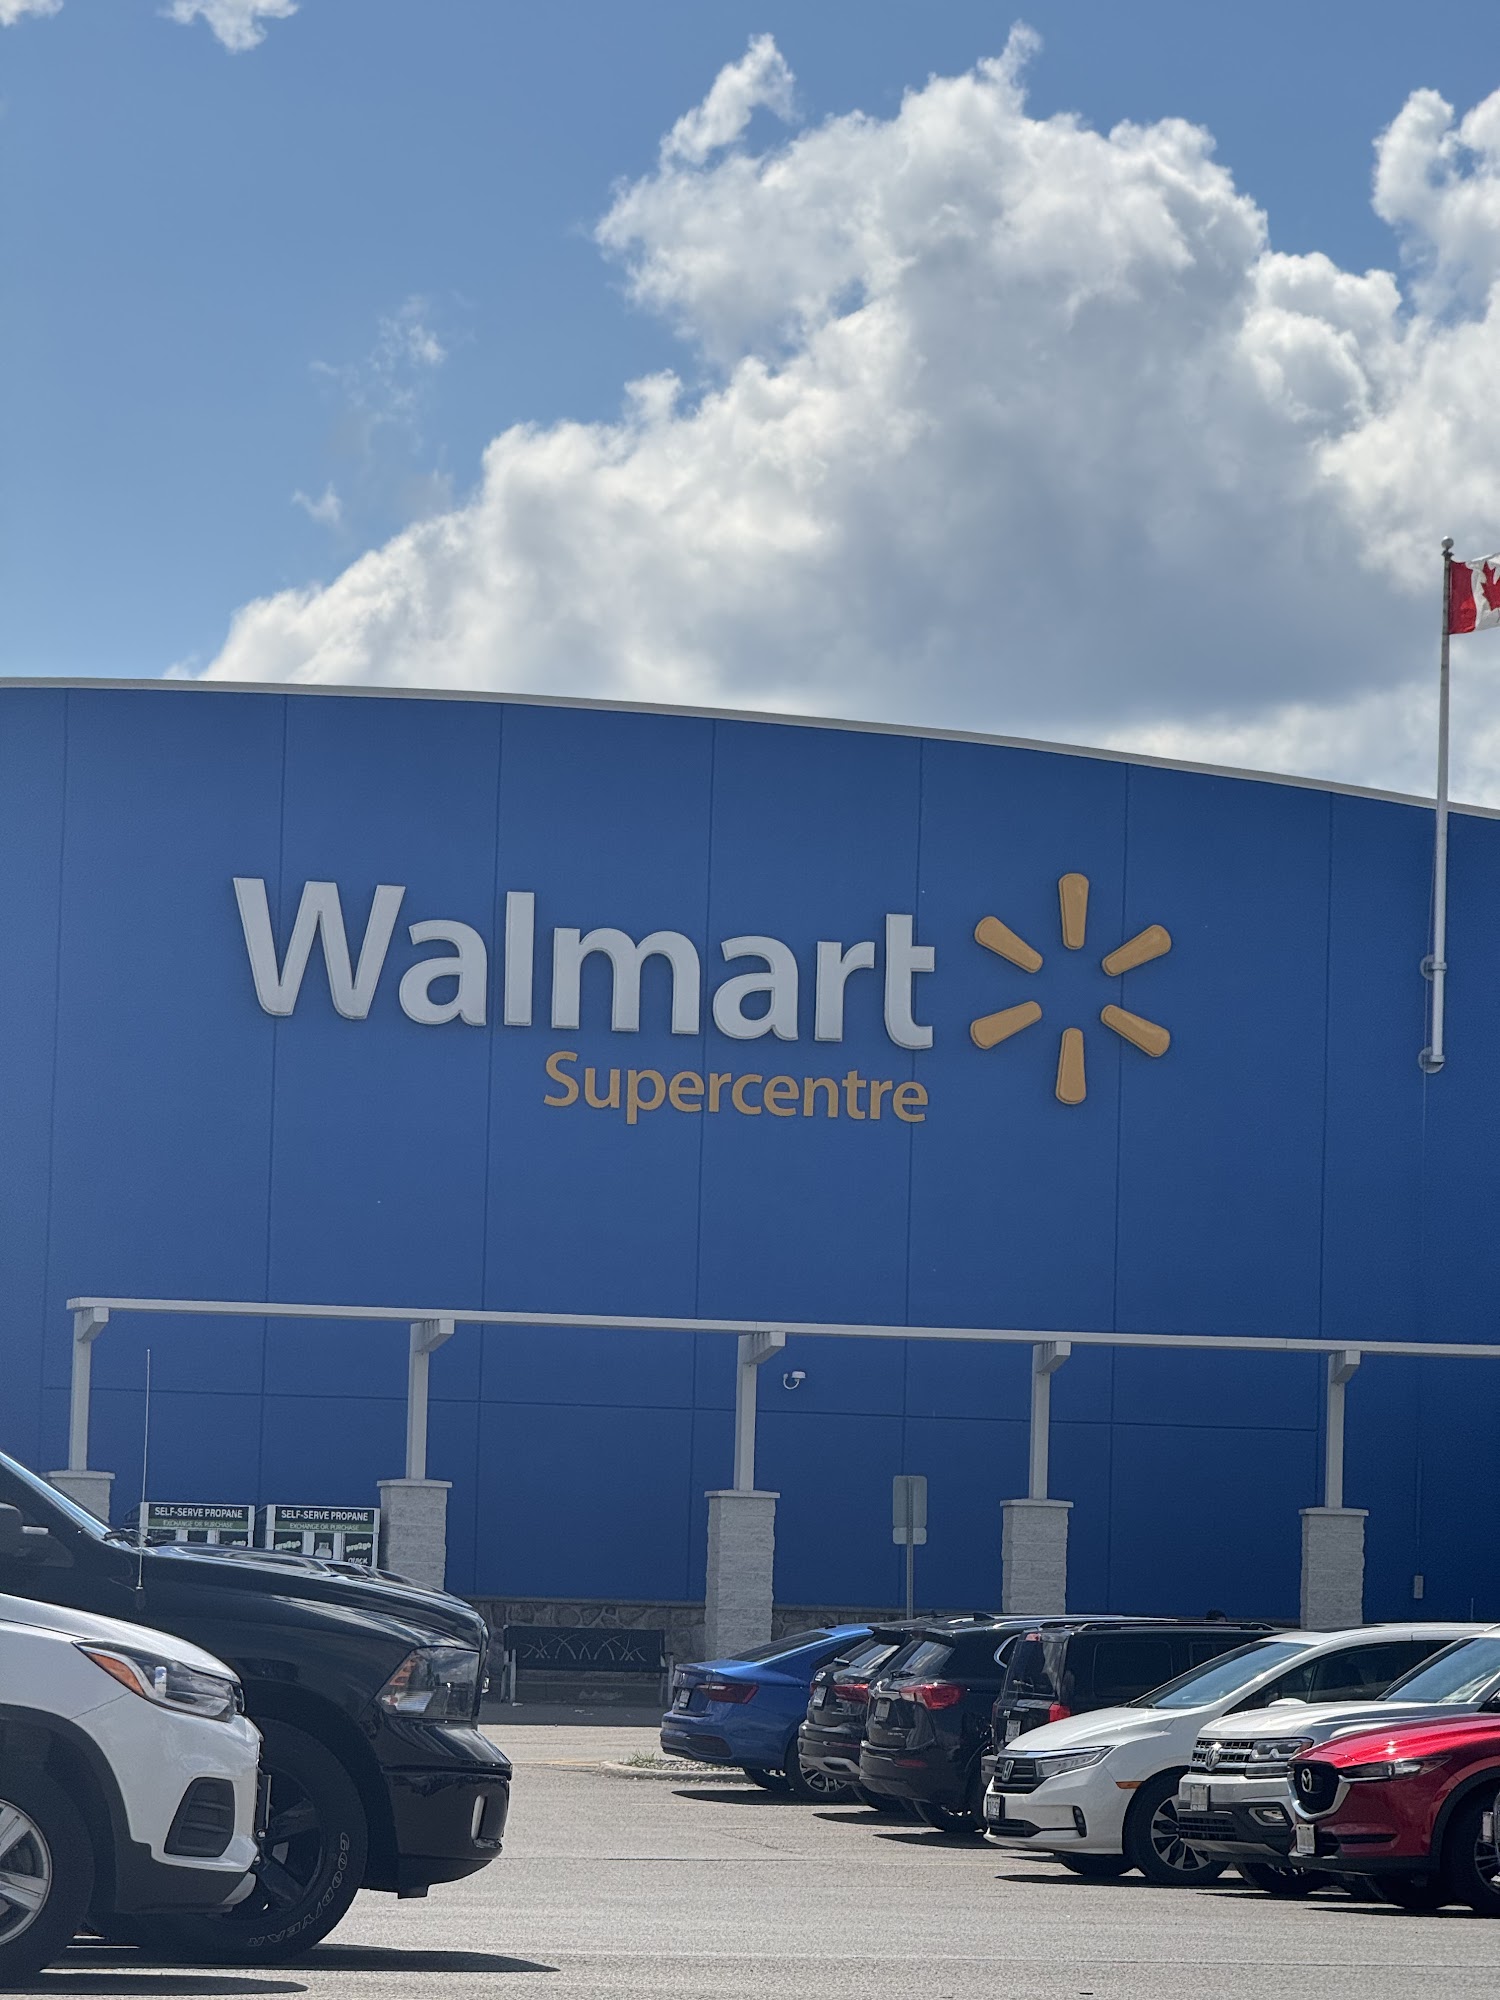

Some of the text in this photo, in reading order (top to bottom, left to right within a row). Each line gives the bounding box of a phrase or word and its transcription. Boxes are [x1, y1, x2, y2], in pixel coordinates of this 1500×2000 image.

[233, 876, 935, 1049] Walmart
[545, 1052, 929, 1125] Supercentre
[154, 1506, 243, 1519] SELF-SERVE PROPANE
[281, 1509, 369, 1522] SELF-SERVE PROPANE
[163, 1520, 234, 1529] EXCHANGE OR PURCHASE
[289, 1522, 319, 1530] EXCHANGE
[330, 1523, 360, 1531] PURCHASE
[345, 1542, 371, 1553] pro2go
